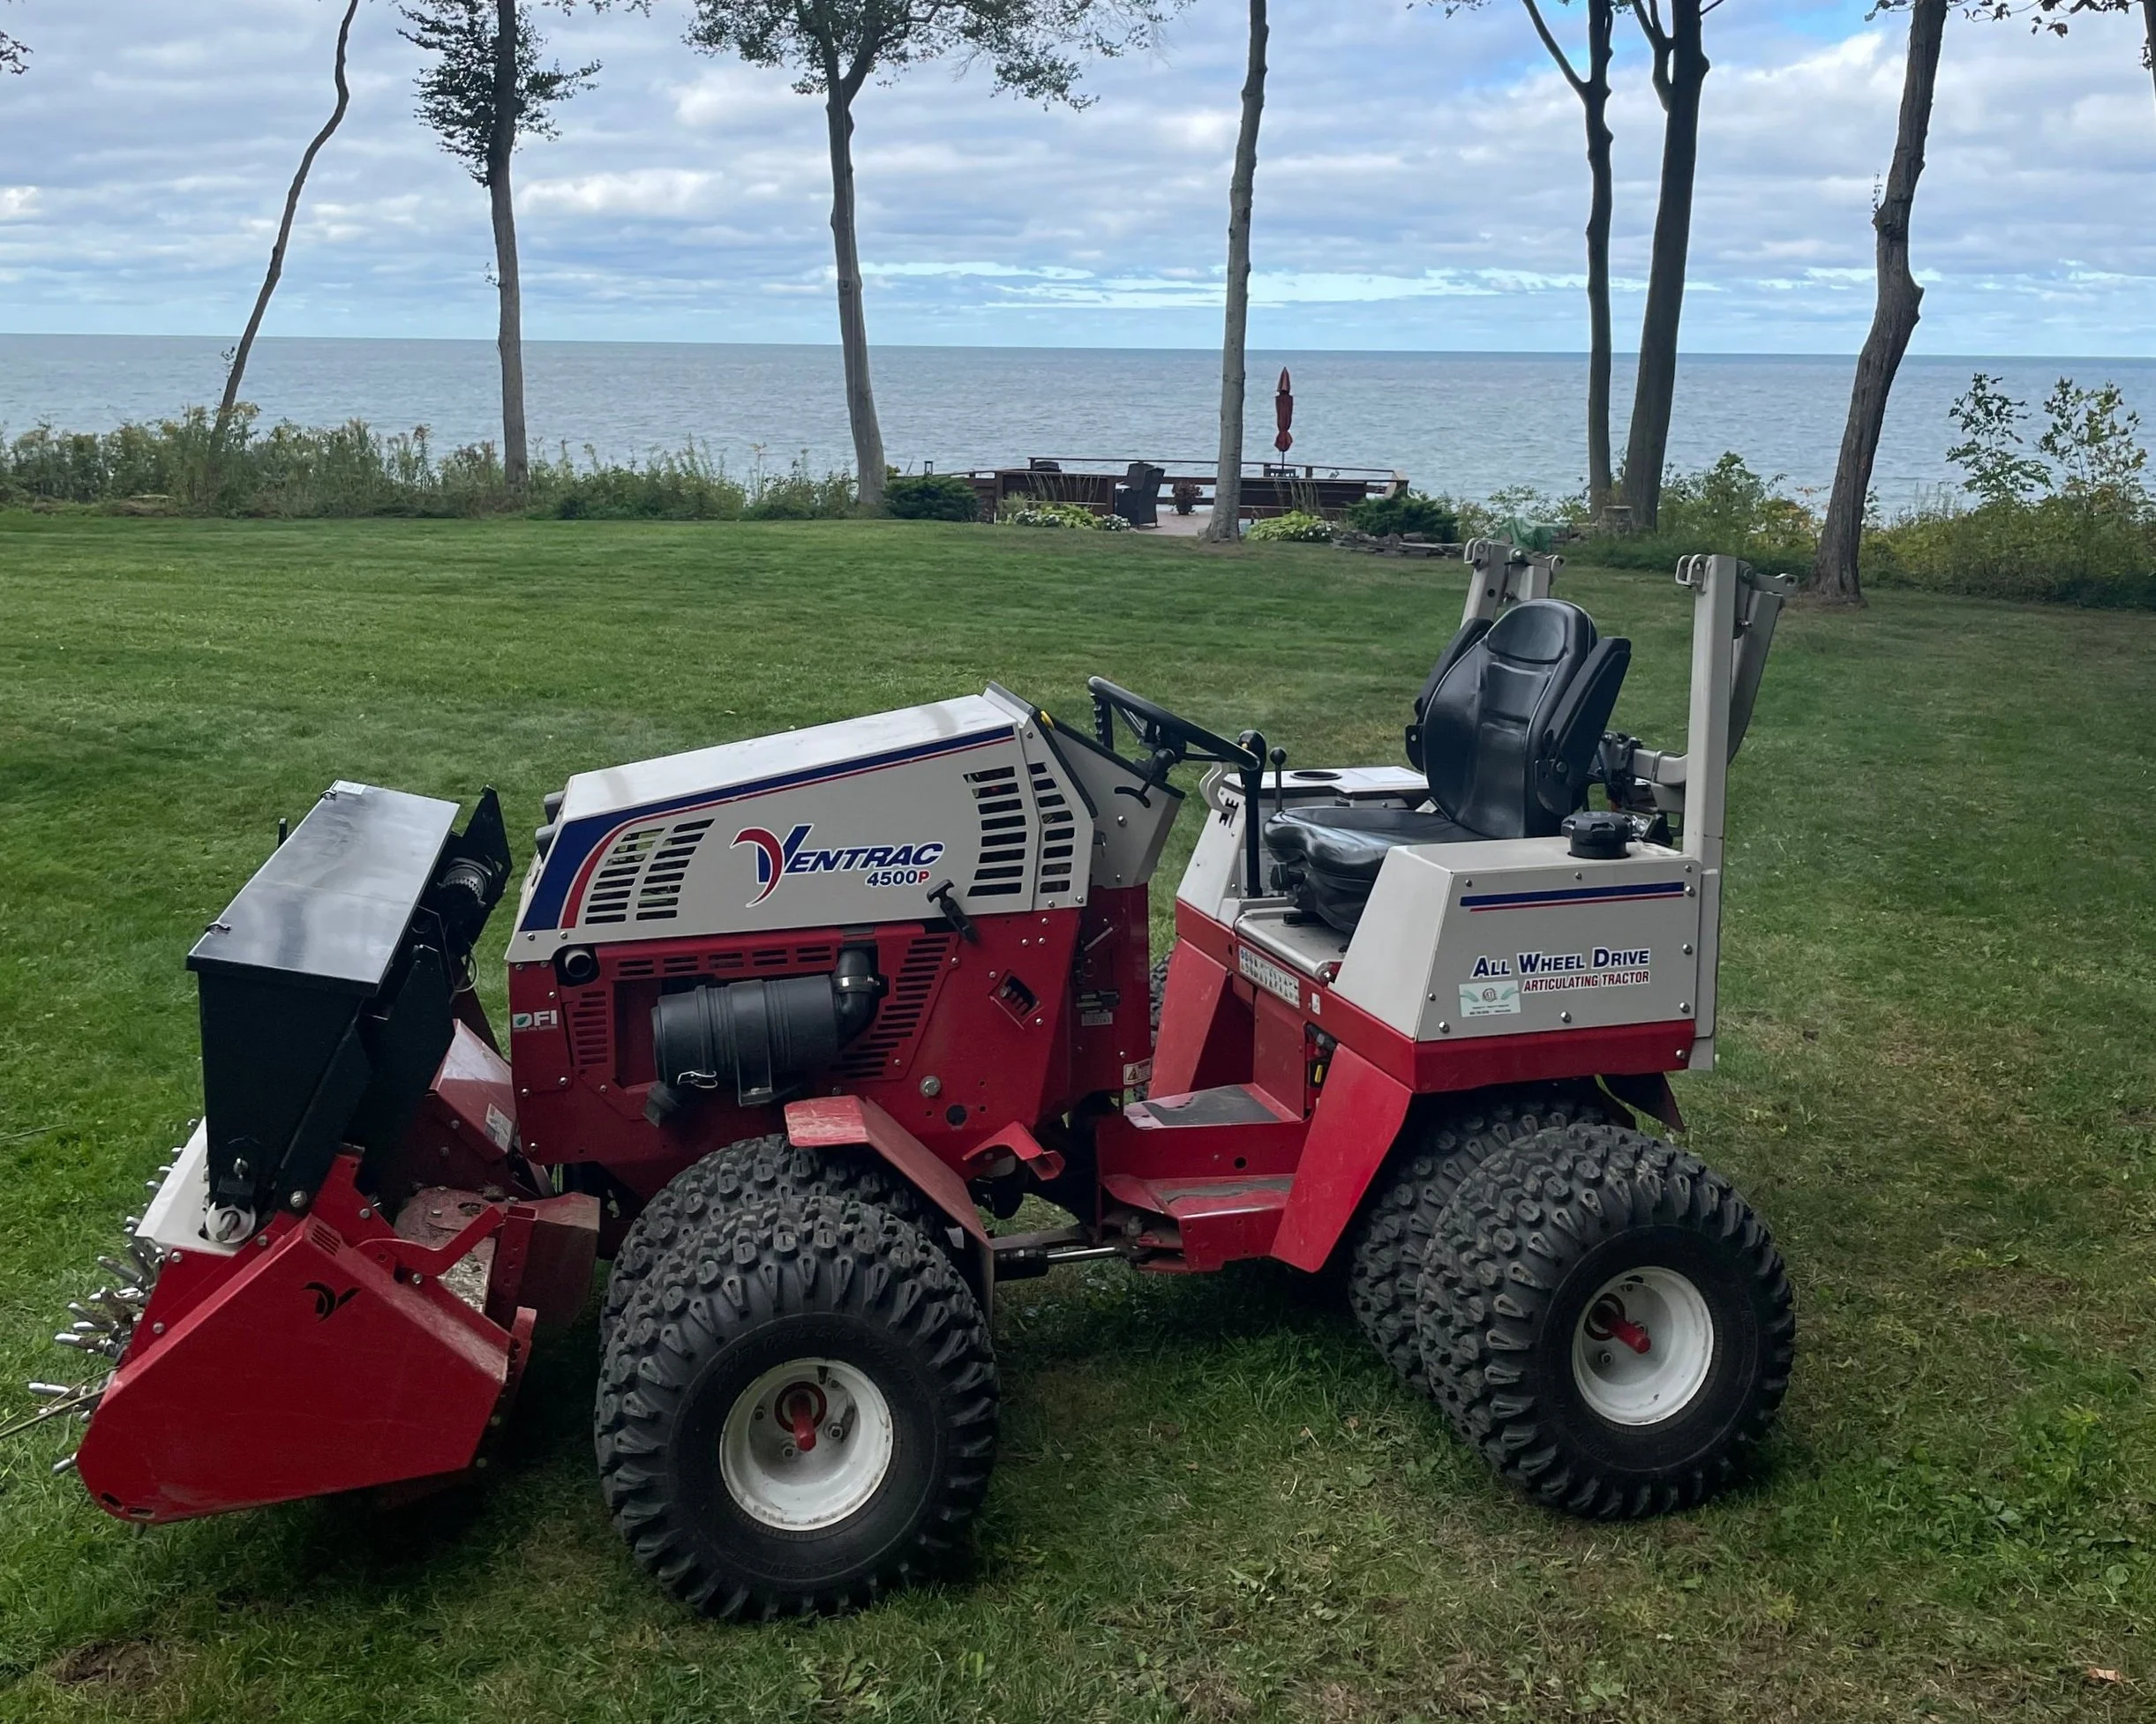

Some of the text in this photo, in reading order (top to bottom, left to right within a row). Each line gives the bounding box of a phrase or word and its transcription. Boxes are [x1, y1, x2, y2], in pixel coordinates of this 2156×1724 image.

[750, 824, 944, 885] VENTRAC
[867, 870, 929, 886] 4500P
[1473, 948, 1649, 977] ALL WHEEL DRIVE
[1524, 971, 1649, 993] ARTICULATING TRACTOR
[513, 1010, 558, 1029] DFI
